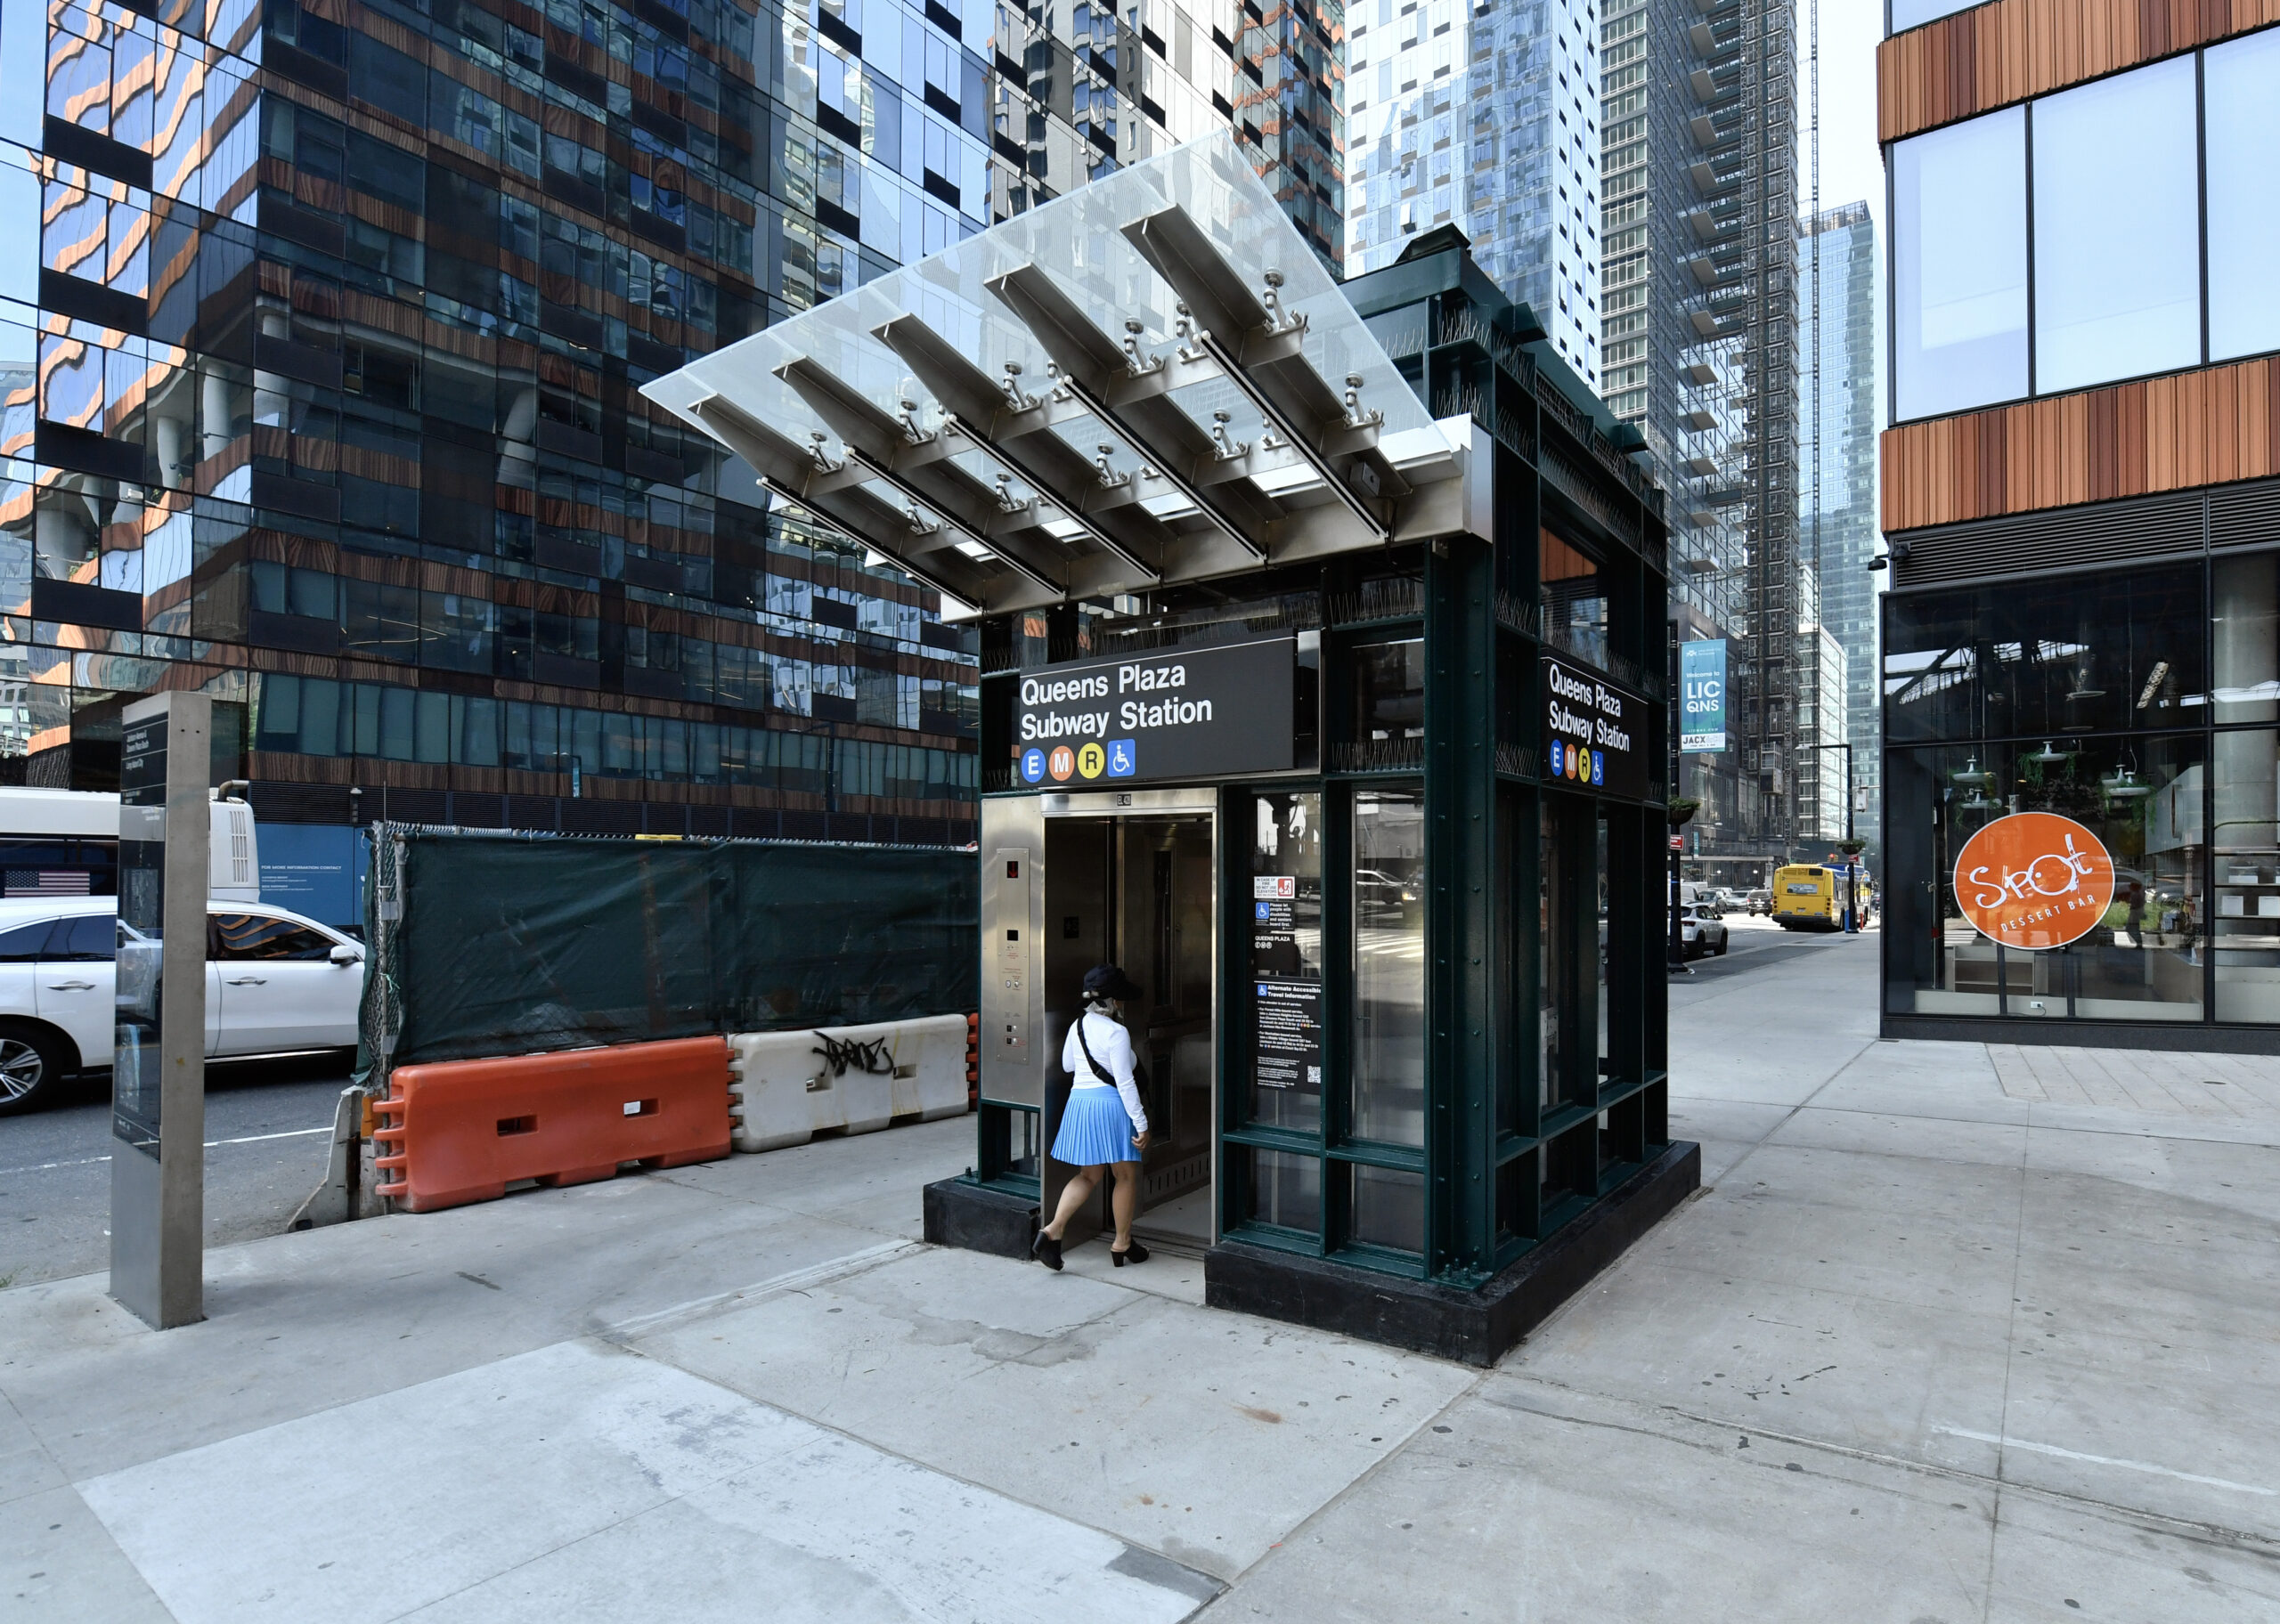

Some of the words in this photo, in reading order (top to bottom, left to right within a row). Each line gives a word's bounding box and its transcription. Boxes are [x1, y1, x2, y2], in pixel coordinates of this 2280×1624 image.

[1021, 676, 1108, 705] Queens
[1119, 664, 1185, 694] Plaza
[1549, 663, 1592, 706] Queens
[1596, 685, 1621, 718] Plaza
[1687, 681, 1721, 699] LIC
[1021, 711, 1110, 740] Subway
[1120, 696, 1212, 730] Station
[1686, 700, 1719, 712] QNS
[1549, 701, 1592, 744] Subway
[1597, 719, 1630, 752] Station
[1682, 735, 1706, 744] JACX
[1028, 755, 1038, 775] E
[1054, 753, 1069, 772] M
[1086, 751, 1097, 769] R
[2000, 905, 2062, 932] DESSERT
[2067, 895, 2096, 911] BAR
